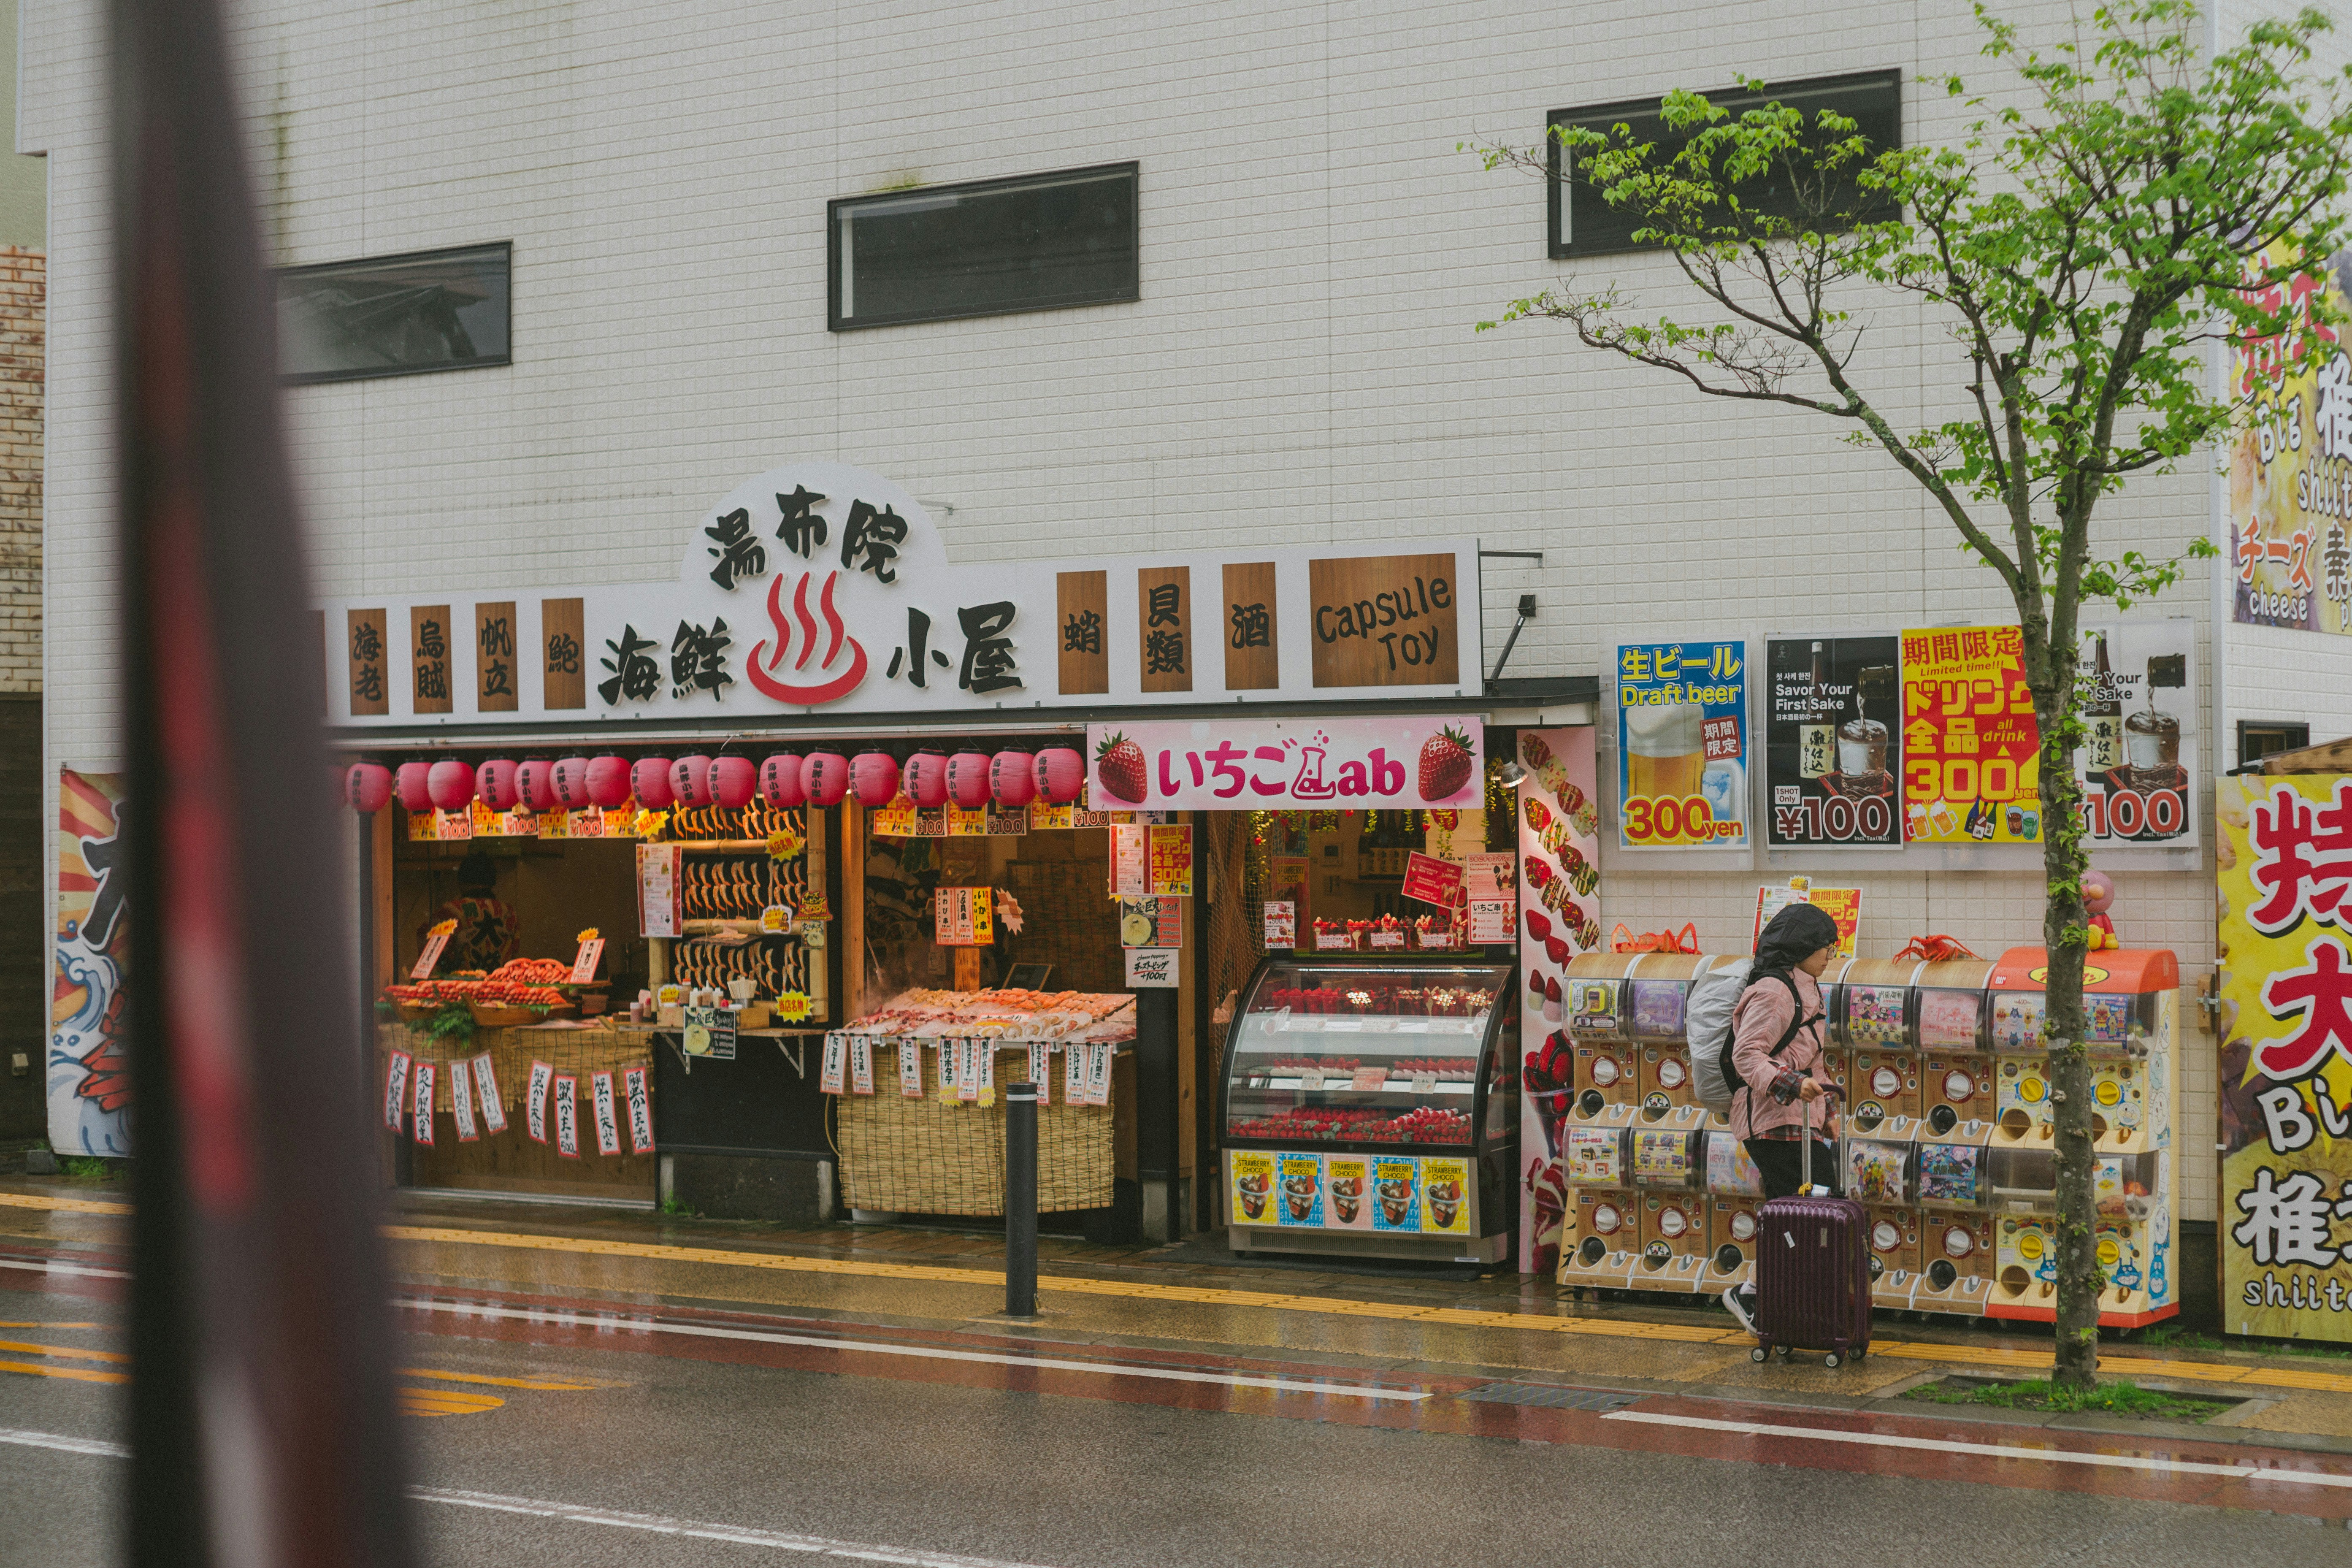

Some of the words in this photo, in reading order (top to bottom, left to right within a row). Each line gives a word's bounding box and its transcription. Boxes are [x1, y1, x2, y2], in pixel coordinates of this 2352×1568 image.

[705, 483, 912, 591] 湯布院
[2238, 514, 2317, 593] チーズ
[1316, 577, 1451, 644] Capsule
[2249, 588, 2308, 622] cheese
[1064, 609, 1101, 655] 蛸
[1145, 583, 1185, 674] 貝類
[1231, 603, 1270, 650] 酒
[352, 622, 382, 702] 海老
[416, 619, 447, 700] 烏賊
[480, 617, 512, 697] 帆立
[547, 633, 579, 674] 鮑
[597, 616, 735, 707] 海鮮
[885, 600, 1027, 695] 小屋
[1620, 644, 1743, 683] 生ビール
[1902, 627, 2023, 667] 期間限定
[1920, 665, 1962, 677] Limited
[1966, 661, 2004, 673] time!!!
[2104, 672, 2142, 686] Your
[1621, 684, 1683, 707] Draft
[1687, 680, 1742, 705] beer
[1776, 684, 1815, 696] Savor
[1819, 683, 1853, 695] Your
[1776, 699, 1807, 711] First
[1810, 698, 1845, 710] Sake
[1903, 679, 2037, 716] ドリンク
[2096, 688, 2133, 701] Sake
[1703, 720, 1736, 739] 期間
[1776, 713, 1823, 721] 日本酒最初の一杯
[1997, 719, 2013, 730] all
[1706, 737, 1737, 756] 限定
[1904, 718, 1979, 755] 全品
[1983, 730, 2026, 743] drink
[1037, 756, 1051, 796] 海鮮小屋
[988, 819, 1023, 834] ¥100
[1075, 810, 1108, 826] ¥100
[1623, 794, 1744, 842] 300yen
[1775, 795, 1891, 841] ¥100
[978, 890, 987, 931] いか串
[1472, 903, 1501, 912] いちご串
[1810, 890, 1854, 902] 期間限定
[1820, 907, 1858, 921] リンク
[1237, 1159, 1270, 1167] STRAWBERRY
[1284, 1161, 1316, 1169] STRAWBERRY
[1378, 1164, 1412, 1173] STRAWBERRY
